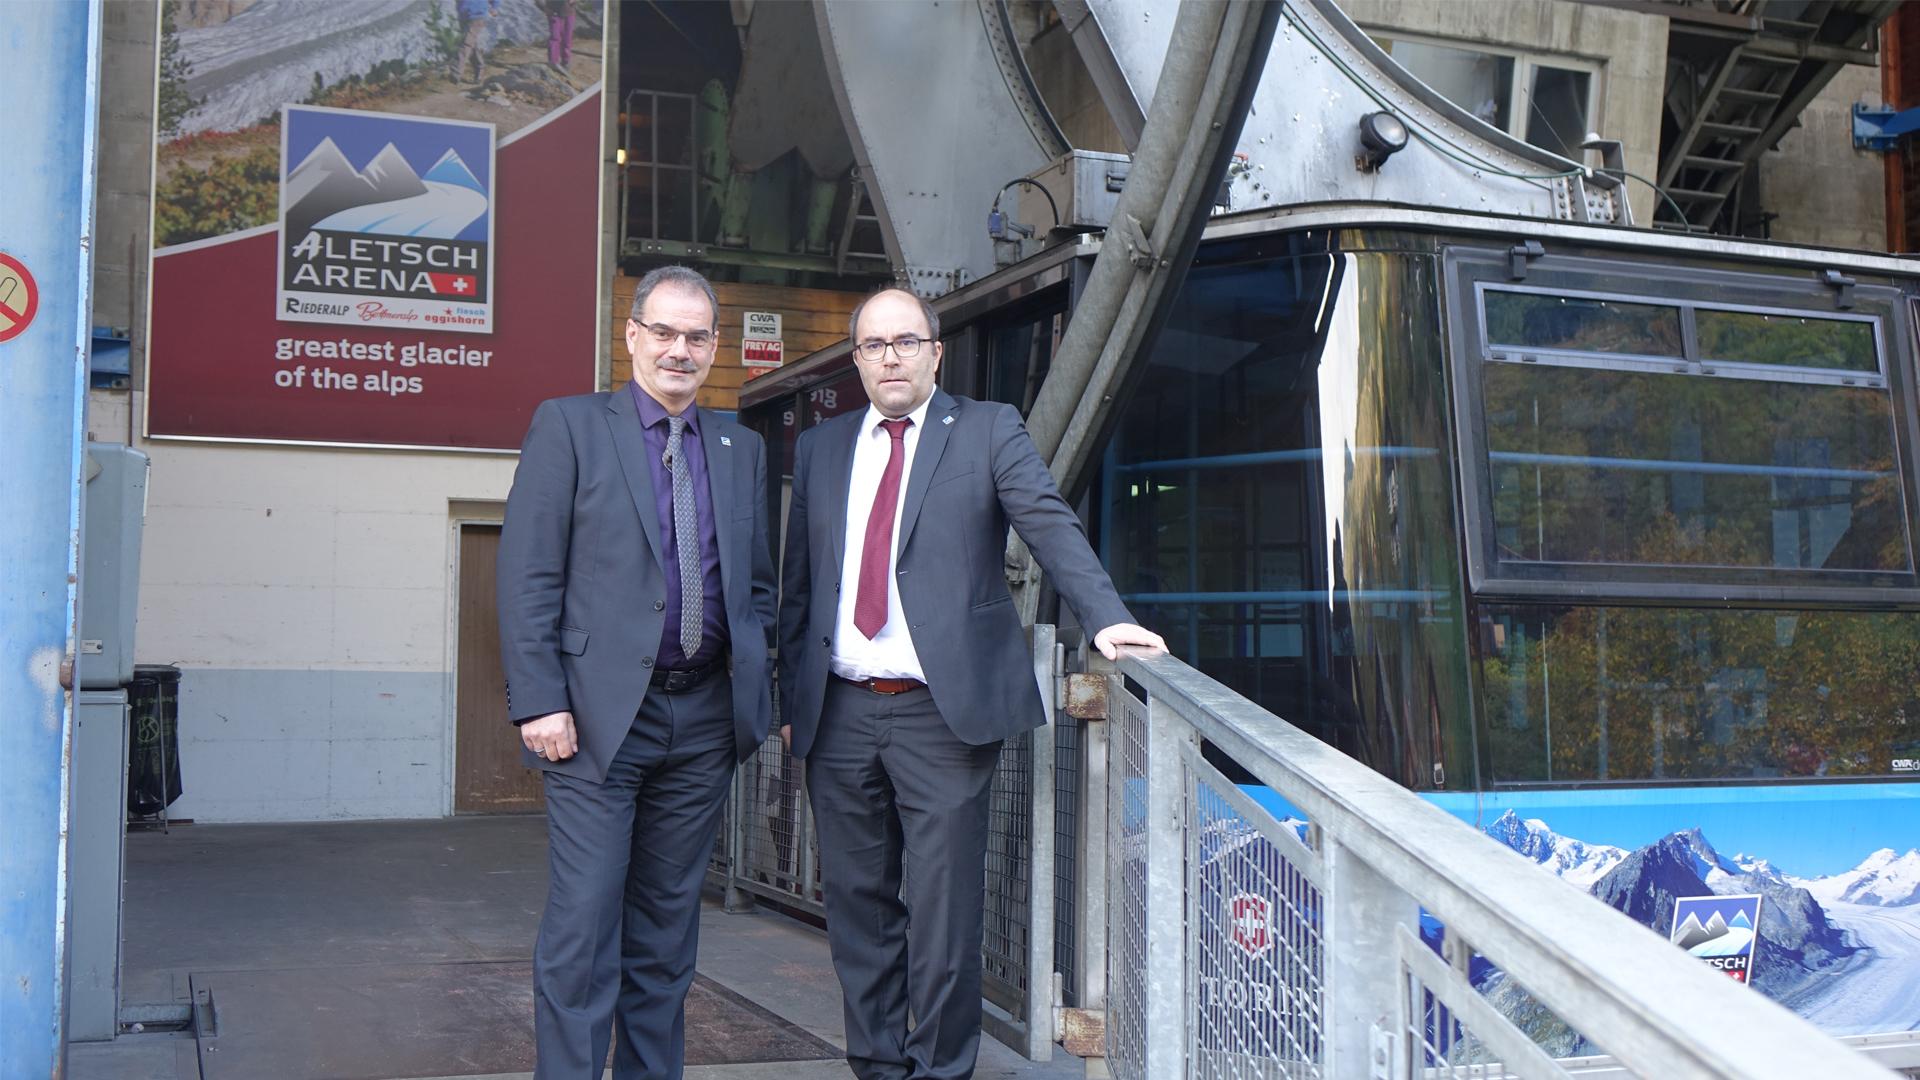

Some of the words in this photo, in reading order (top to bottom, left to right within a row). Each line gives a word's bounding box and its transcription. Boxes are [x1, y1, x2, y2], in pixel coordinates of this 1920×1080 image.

[292, 231, 478, 269] ALETSCH
[292, 263, 436, 293] ARENA
[286, 297, 350, 316] RIEDERALP
[456, 307, 485, 316] fiesch
[424, 313, 485, 325] eggishorn
[750, 313, 776, 323] CWA
[275, 338, 395, 361] greatest
[400, 341, 493, 367] glacier
[745, 341, 766, 351] FREY
[767, 343, 780, 351] AG
[275, 366, 306, 387] of
[311, 367, 357, 390] the
[364, 370, 423, 396] alps
[1705, 957, 1746, 969] TSCH
[1201, 975, 1321, 1021] TORIN
